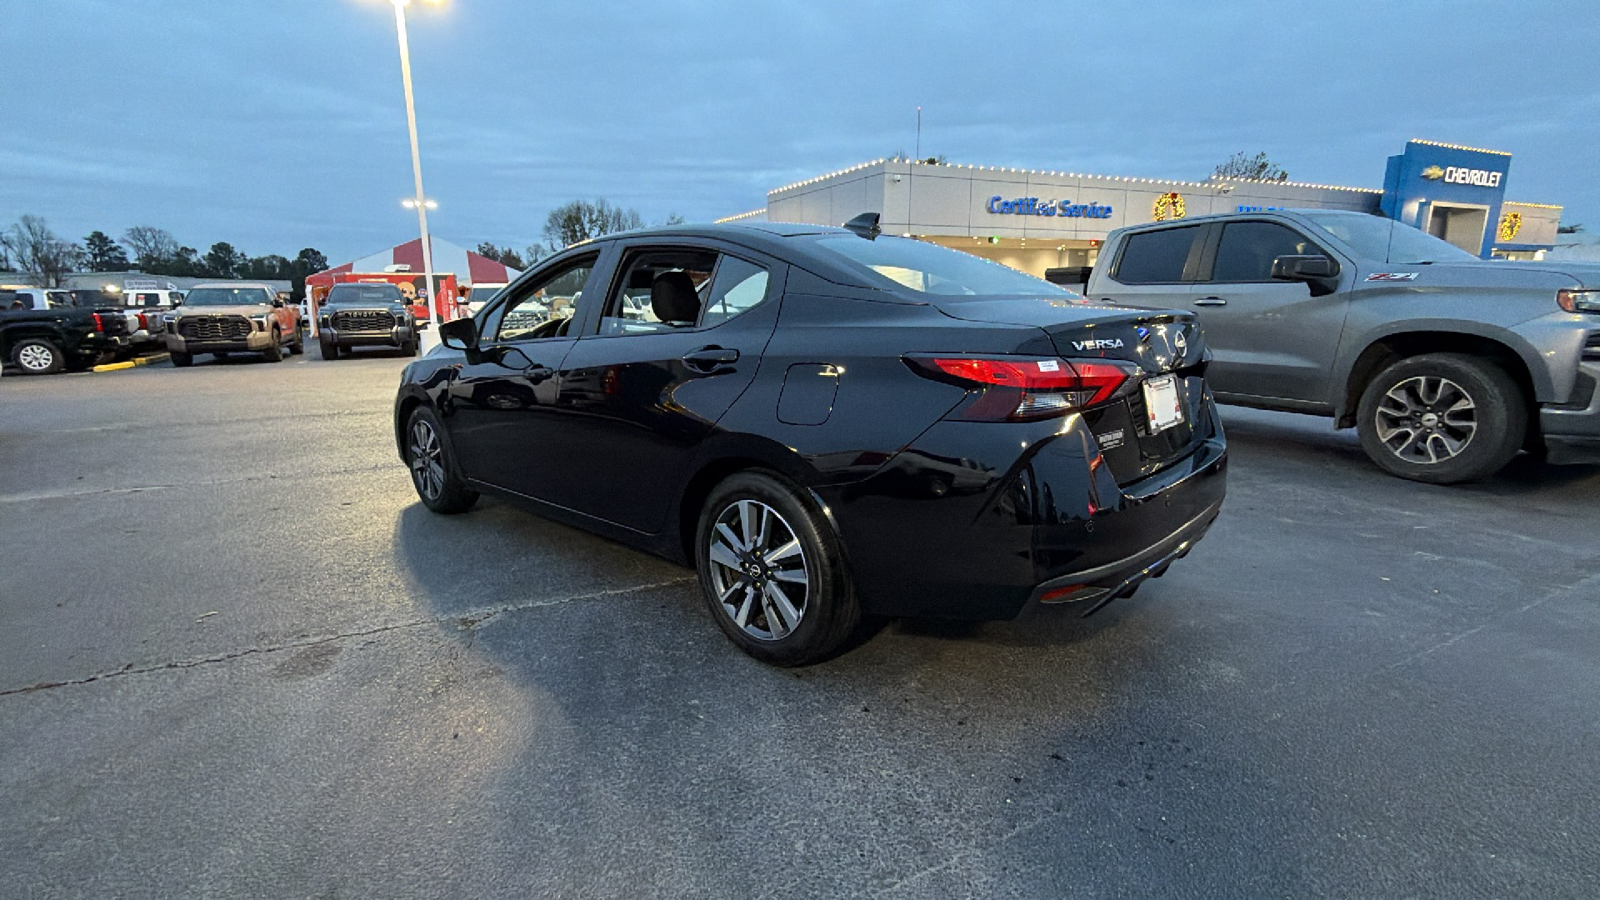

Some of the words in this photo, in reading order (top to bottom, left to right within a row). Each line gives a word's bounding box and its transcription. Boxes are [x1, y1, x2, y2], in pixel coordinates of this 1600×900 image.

[1445, 166, 1503, 188] CHEVROLET
[987, 196, 1057, 216] Certified
[1059, 200, 1113, 218] Service
[1071, 338, 1124, 350] VERSA
